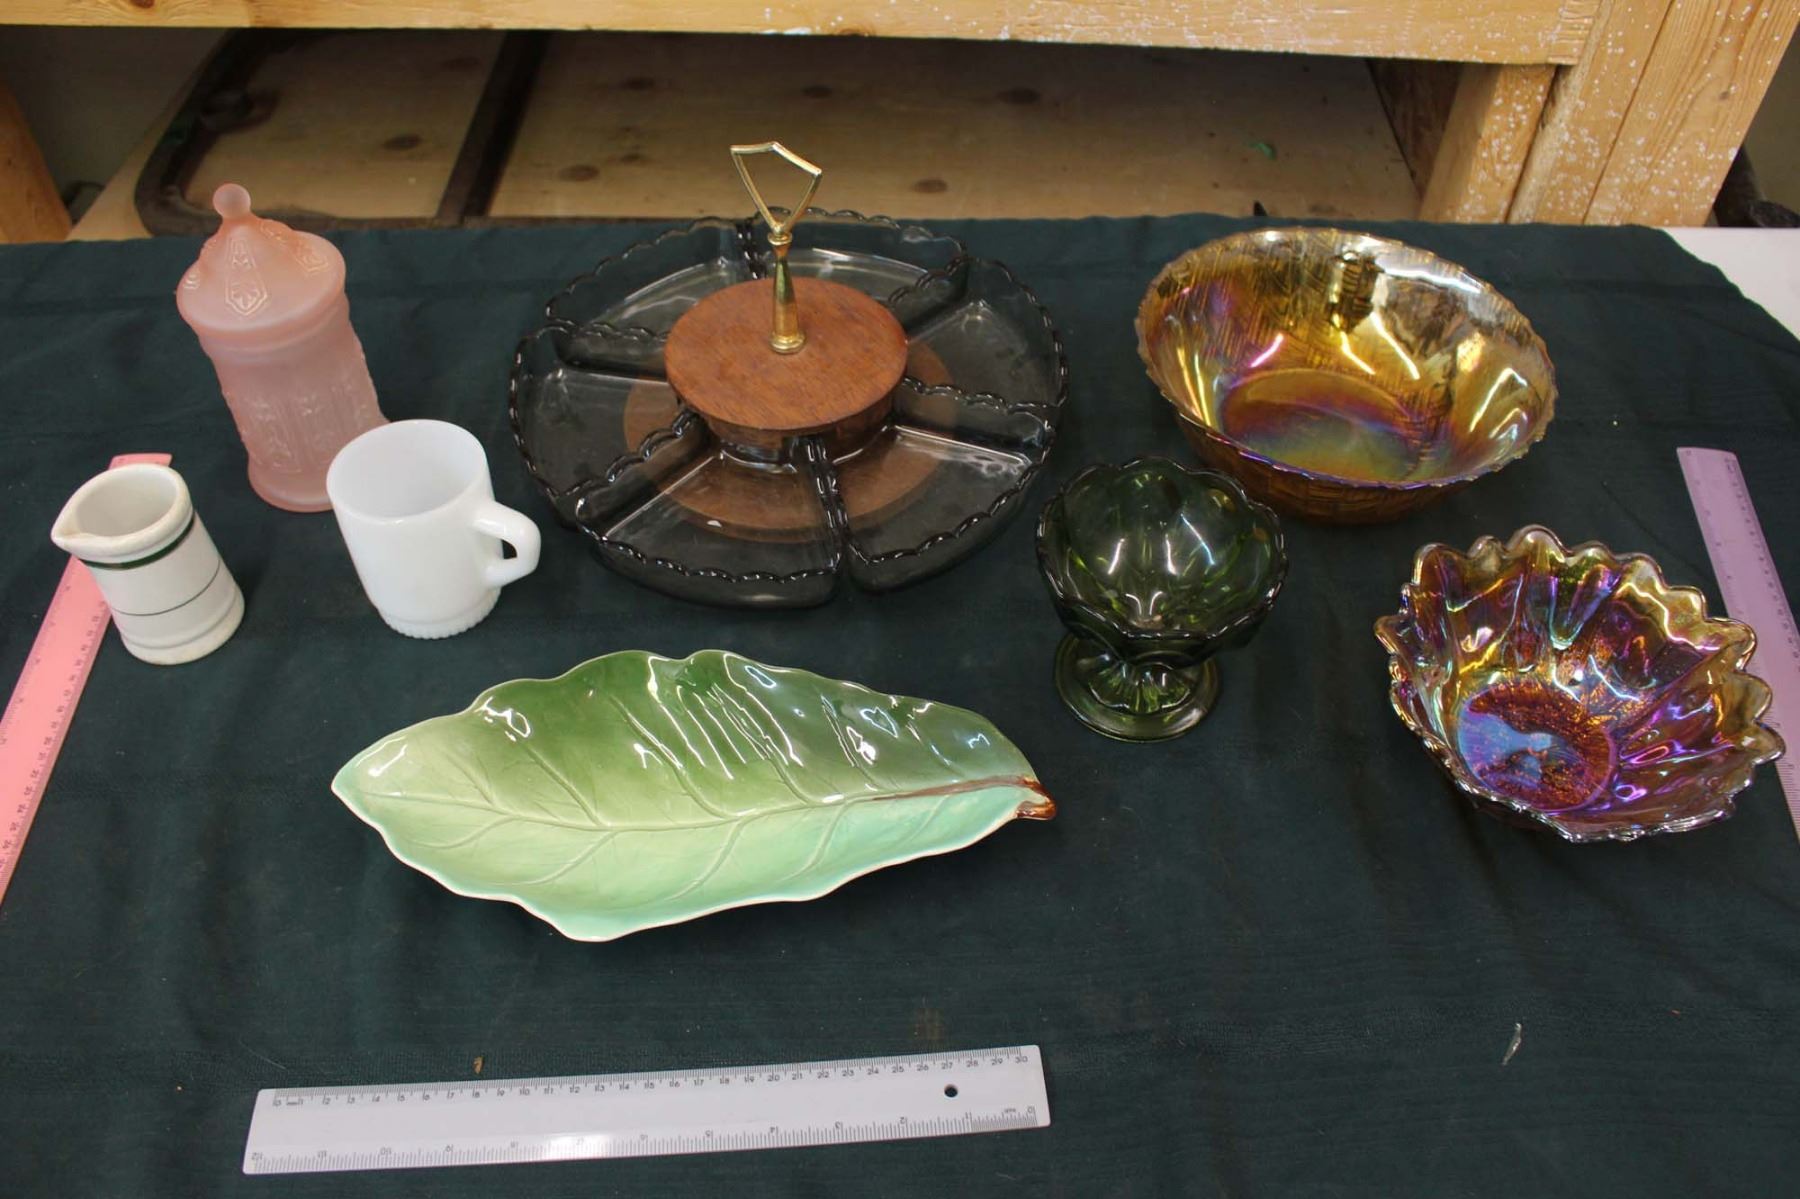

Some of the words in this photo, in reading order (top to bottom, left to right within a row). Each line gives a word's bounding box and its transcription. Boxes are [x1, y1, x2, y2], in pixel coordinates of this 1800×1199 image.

[519, 1088, 530, 1096] 10
[569, 1086, 580, 1094] 12
[619, 1083, 630, 1091] 14
[669, 1080, 680, 1088] 16
[694, 1079, 704, 1087] 17
[767, 1074, 780, 1082] 20
[817, 1071, 829, 1079] 22
[917, 1064, 929, 1072] 26
[941, 1062, 953, 1070] 27
[966, 1060, 979, 1068] 28
[991, 1058, 1003, 1066] 29
